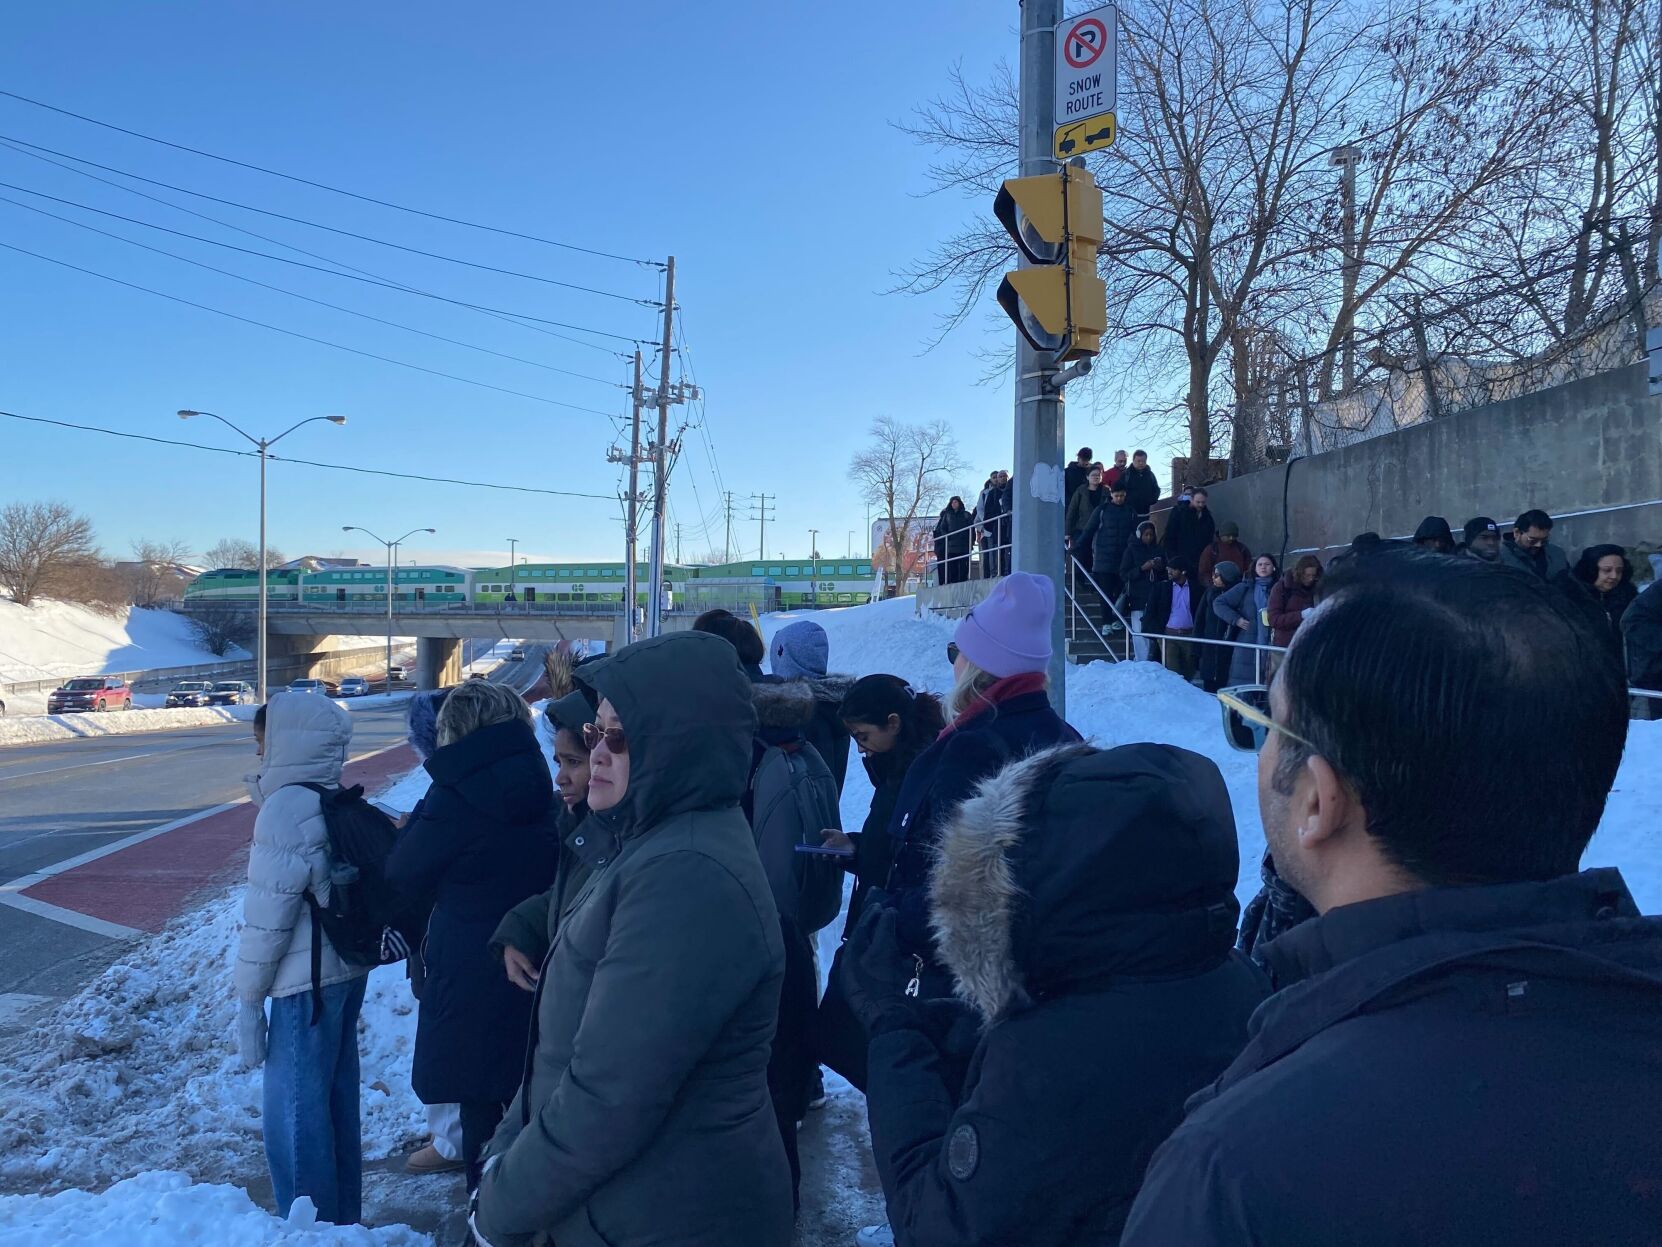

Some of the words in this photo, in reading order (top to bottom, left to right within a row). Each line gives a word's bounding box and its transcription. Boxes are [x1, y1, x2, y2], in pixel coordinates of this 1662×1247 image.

[1069, 73, 1101, 96] SNOW
[1066, 91, 1103, 115] ROUTE
[818, 582, 835, 592] GO
